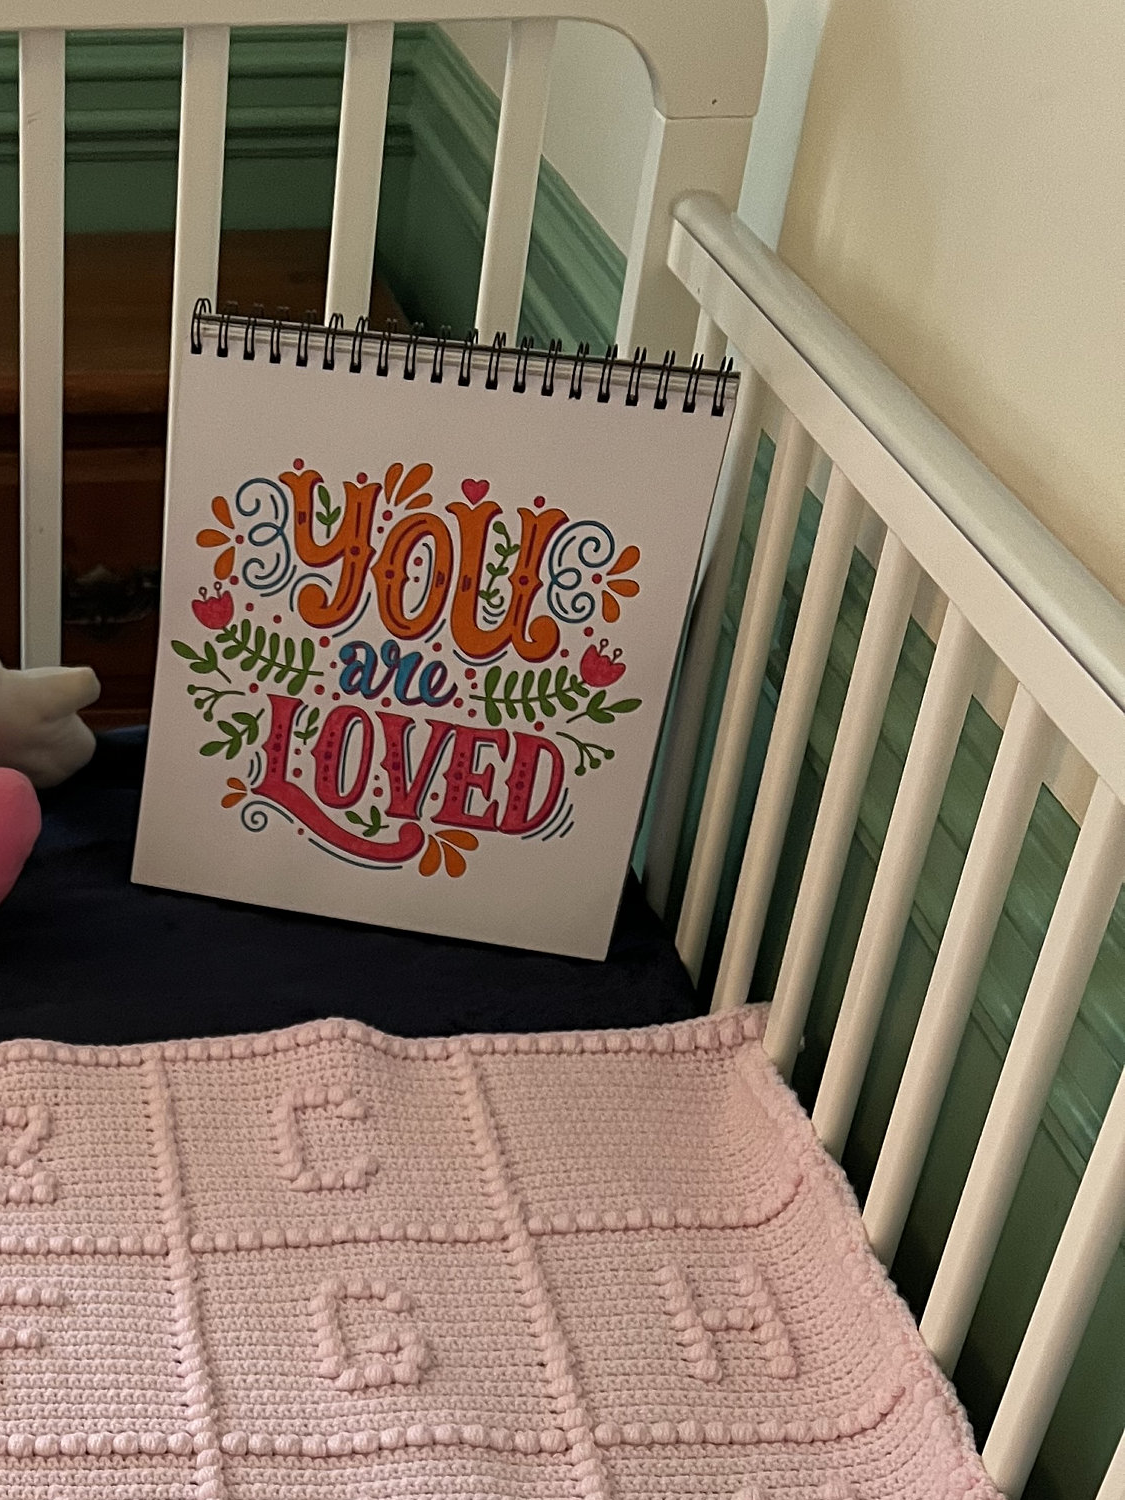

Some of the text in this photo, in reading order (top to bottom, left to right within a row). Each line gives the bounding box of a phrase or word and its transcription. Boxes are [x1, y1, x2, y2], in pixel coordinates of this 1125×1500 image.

[279, 469, 569, 662] YOU
[338, 640, 457, 705] are
[251, 694, 565, 863] LOVED
[276, 1086, 378, 1193] C
[310, 1275, 429, 1391] G
[657, 1262, 798, 1383] H
